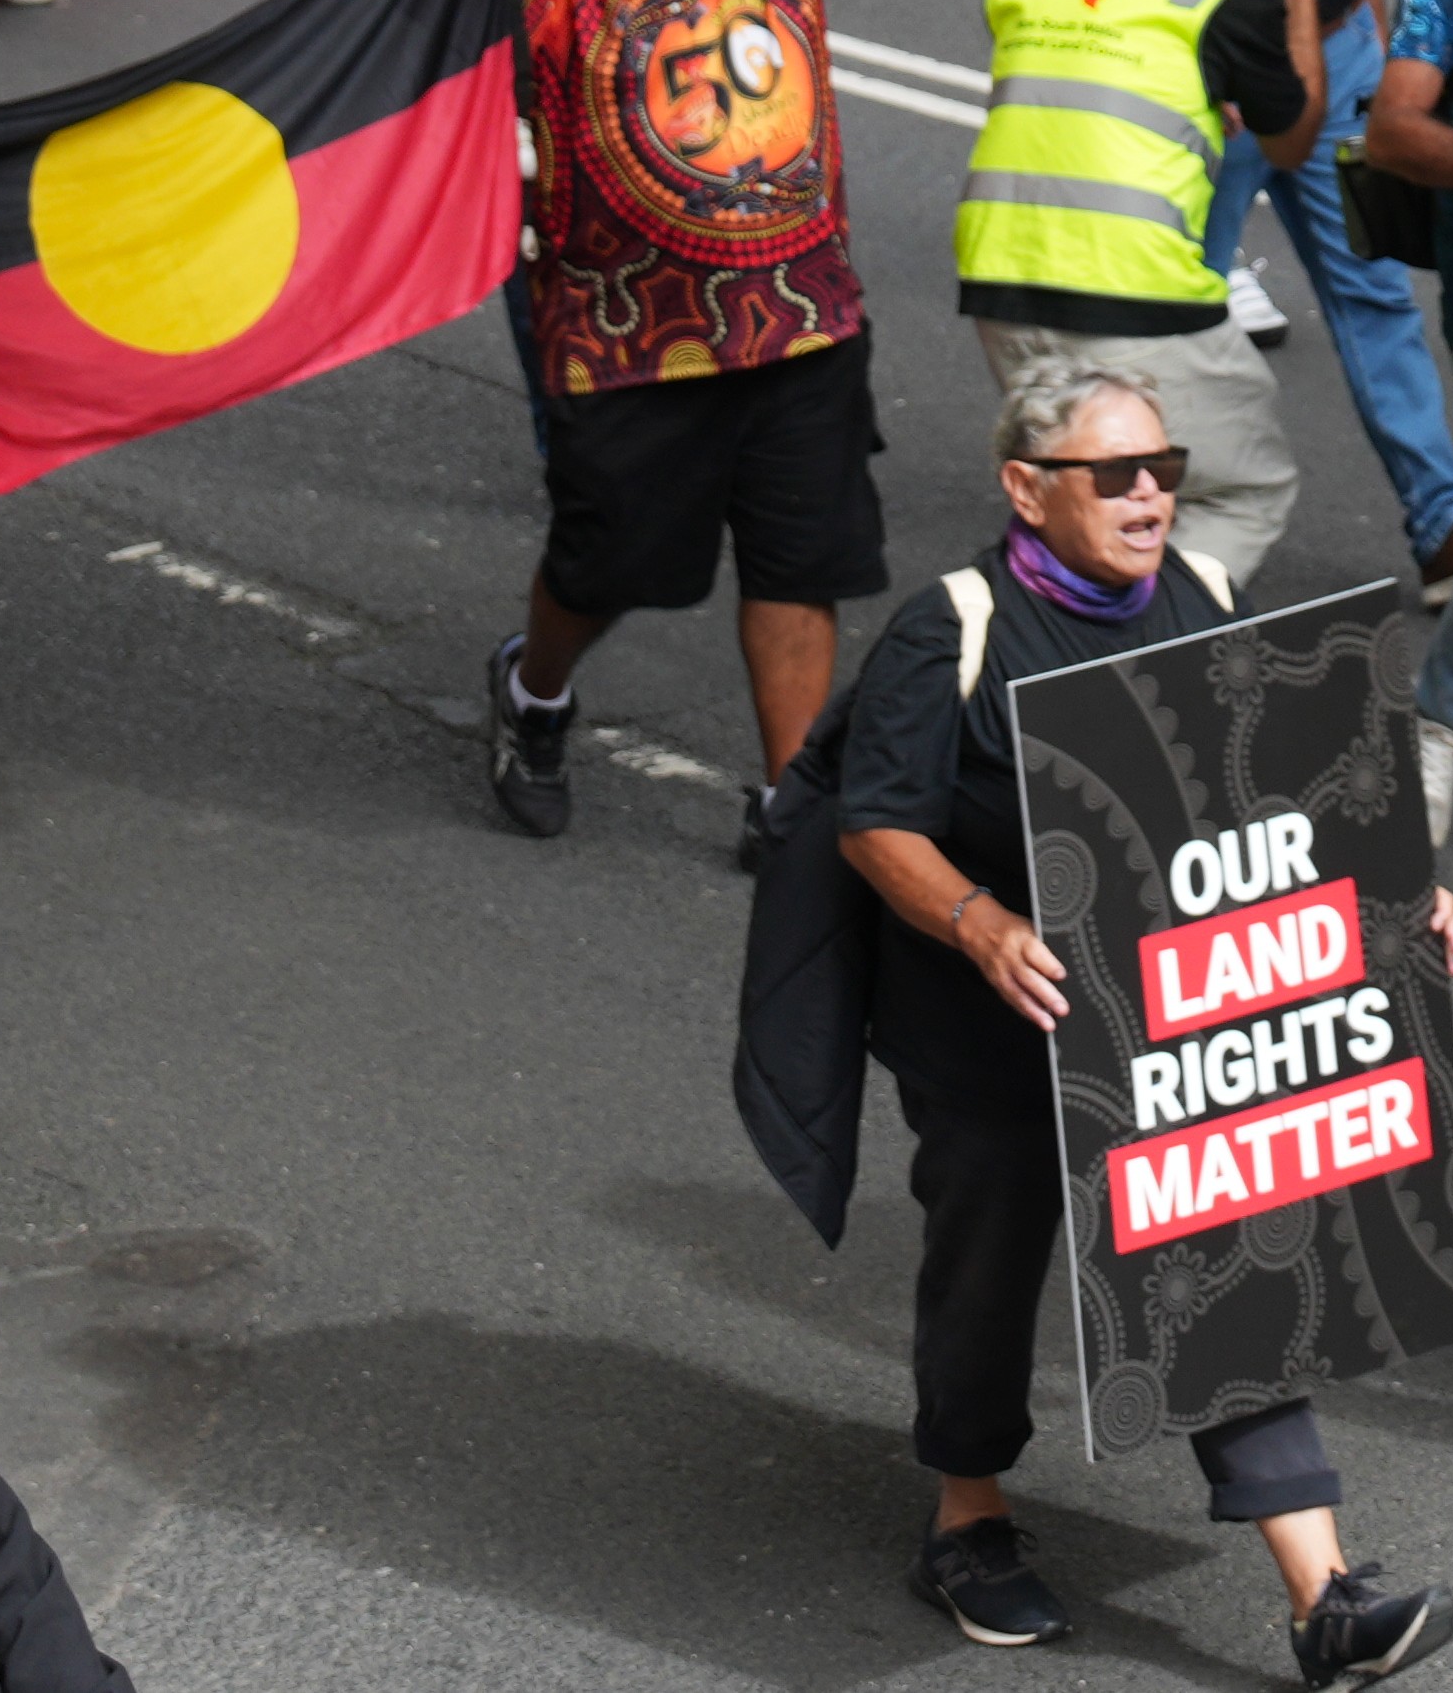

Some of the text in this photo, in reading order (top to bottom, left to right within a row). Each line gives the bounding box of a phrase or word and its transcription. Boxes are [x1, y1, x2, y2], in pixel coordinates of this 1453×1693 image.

[1170, 811, 1320, 918] OUR
[1157, 902, 1348, 1023] LAND
[1130, 987, 1394, 1132] RIGHTS
[1124, 1078, 1420, 1233] MATTER
